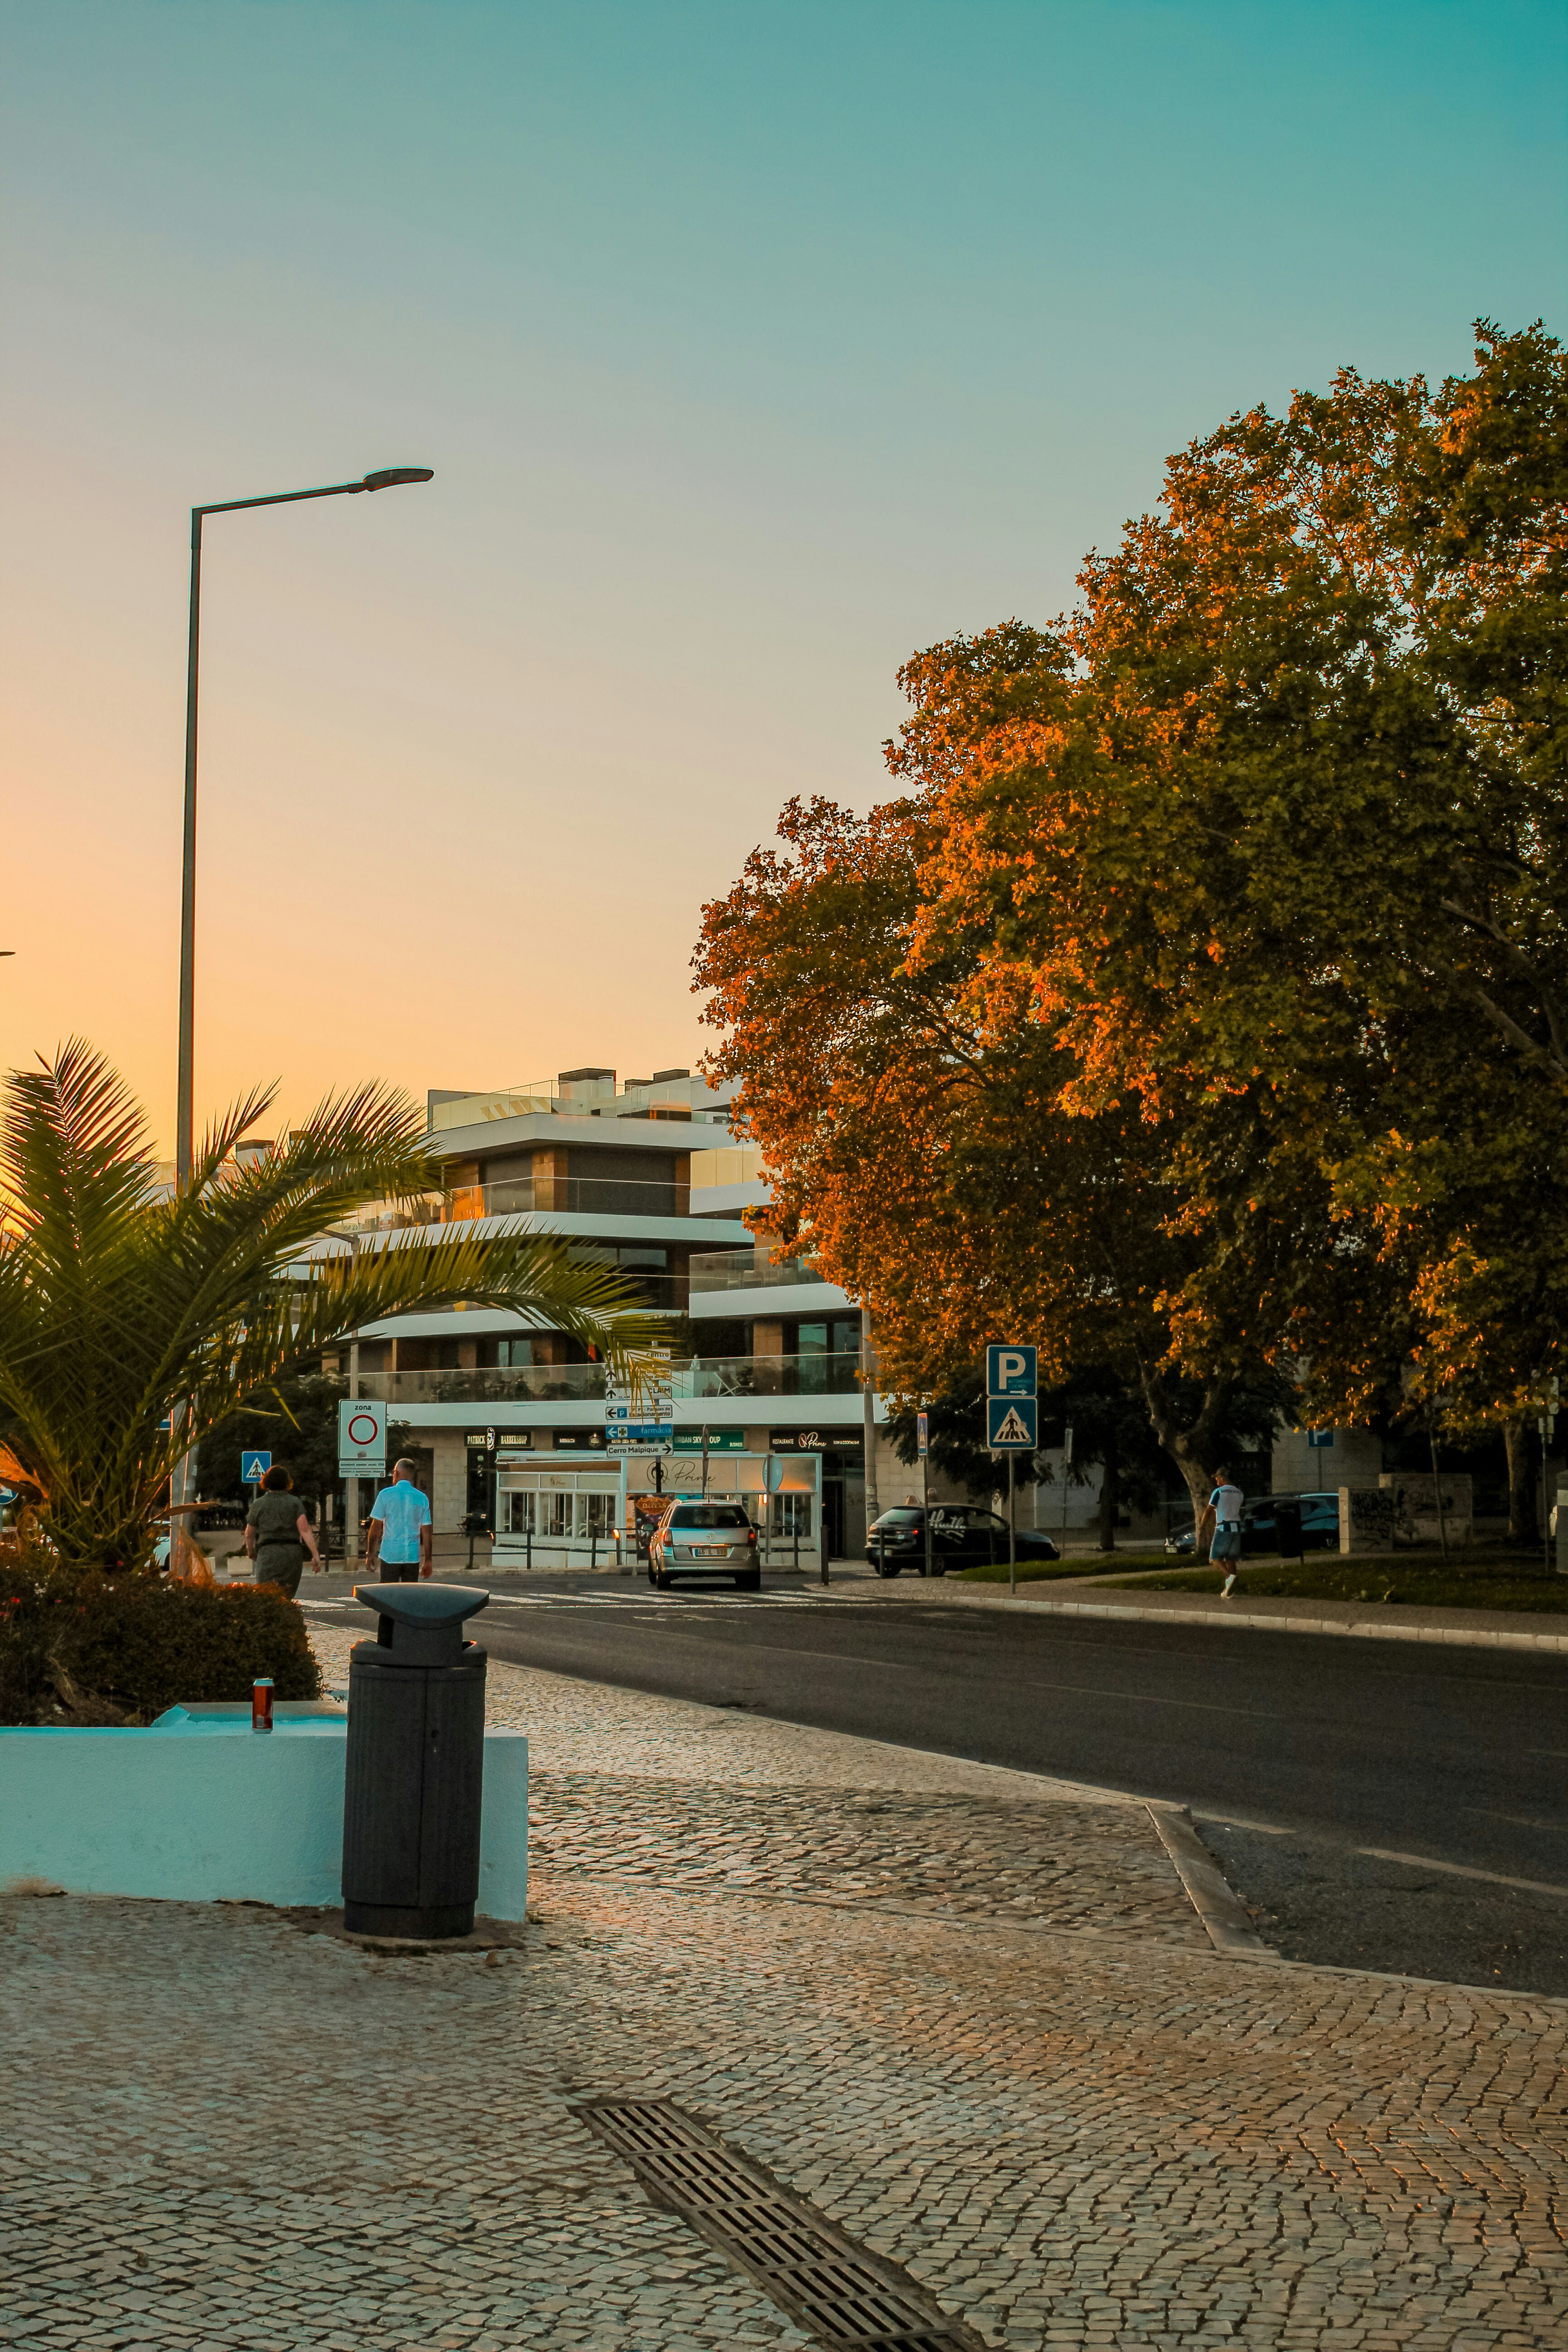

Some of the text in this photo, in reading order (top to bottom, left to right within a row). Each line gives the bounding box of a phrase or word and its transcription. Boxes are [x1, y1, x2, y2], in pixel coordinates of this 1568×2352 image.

[999, 1352, 1026, 1389] P
[467, 1436, 527, 1444] PATRICK BARBERSHOP
[628, 1446, 659, 1454] Malpique
